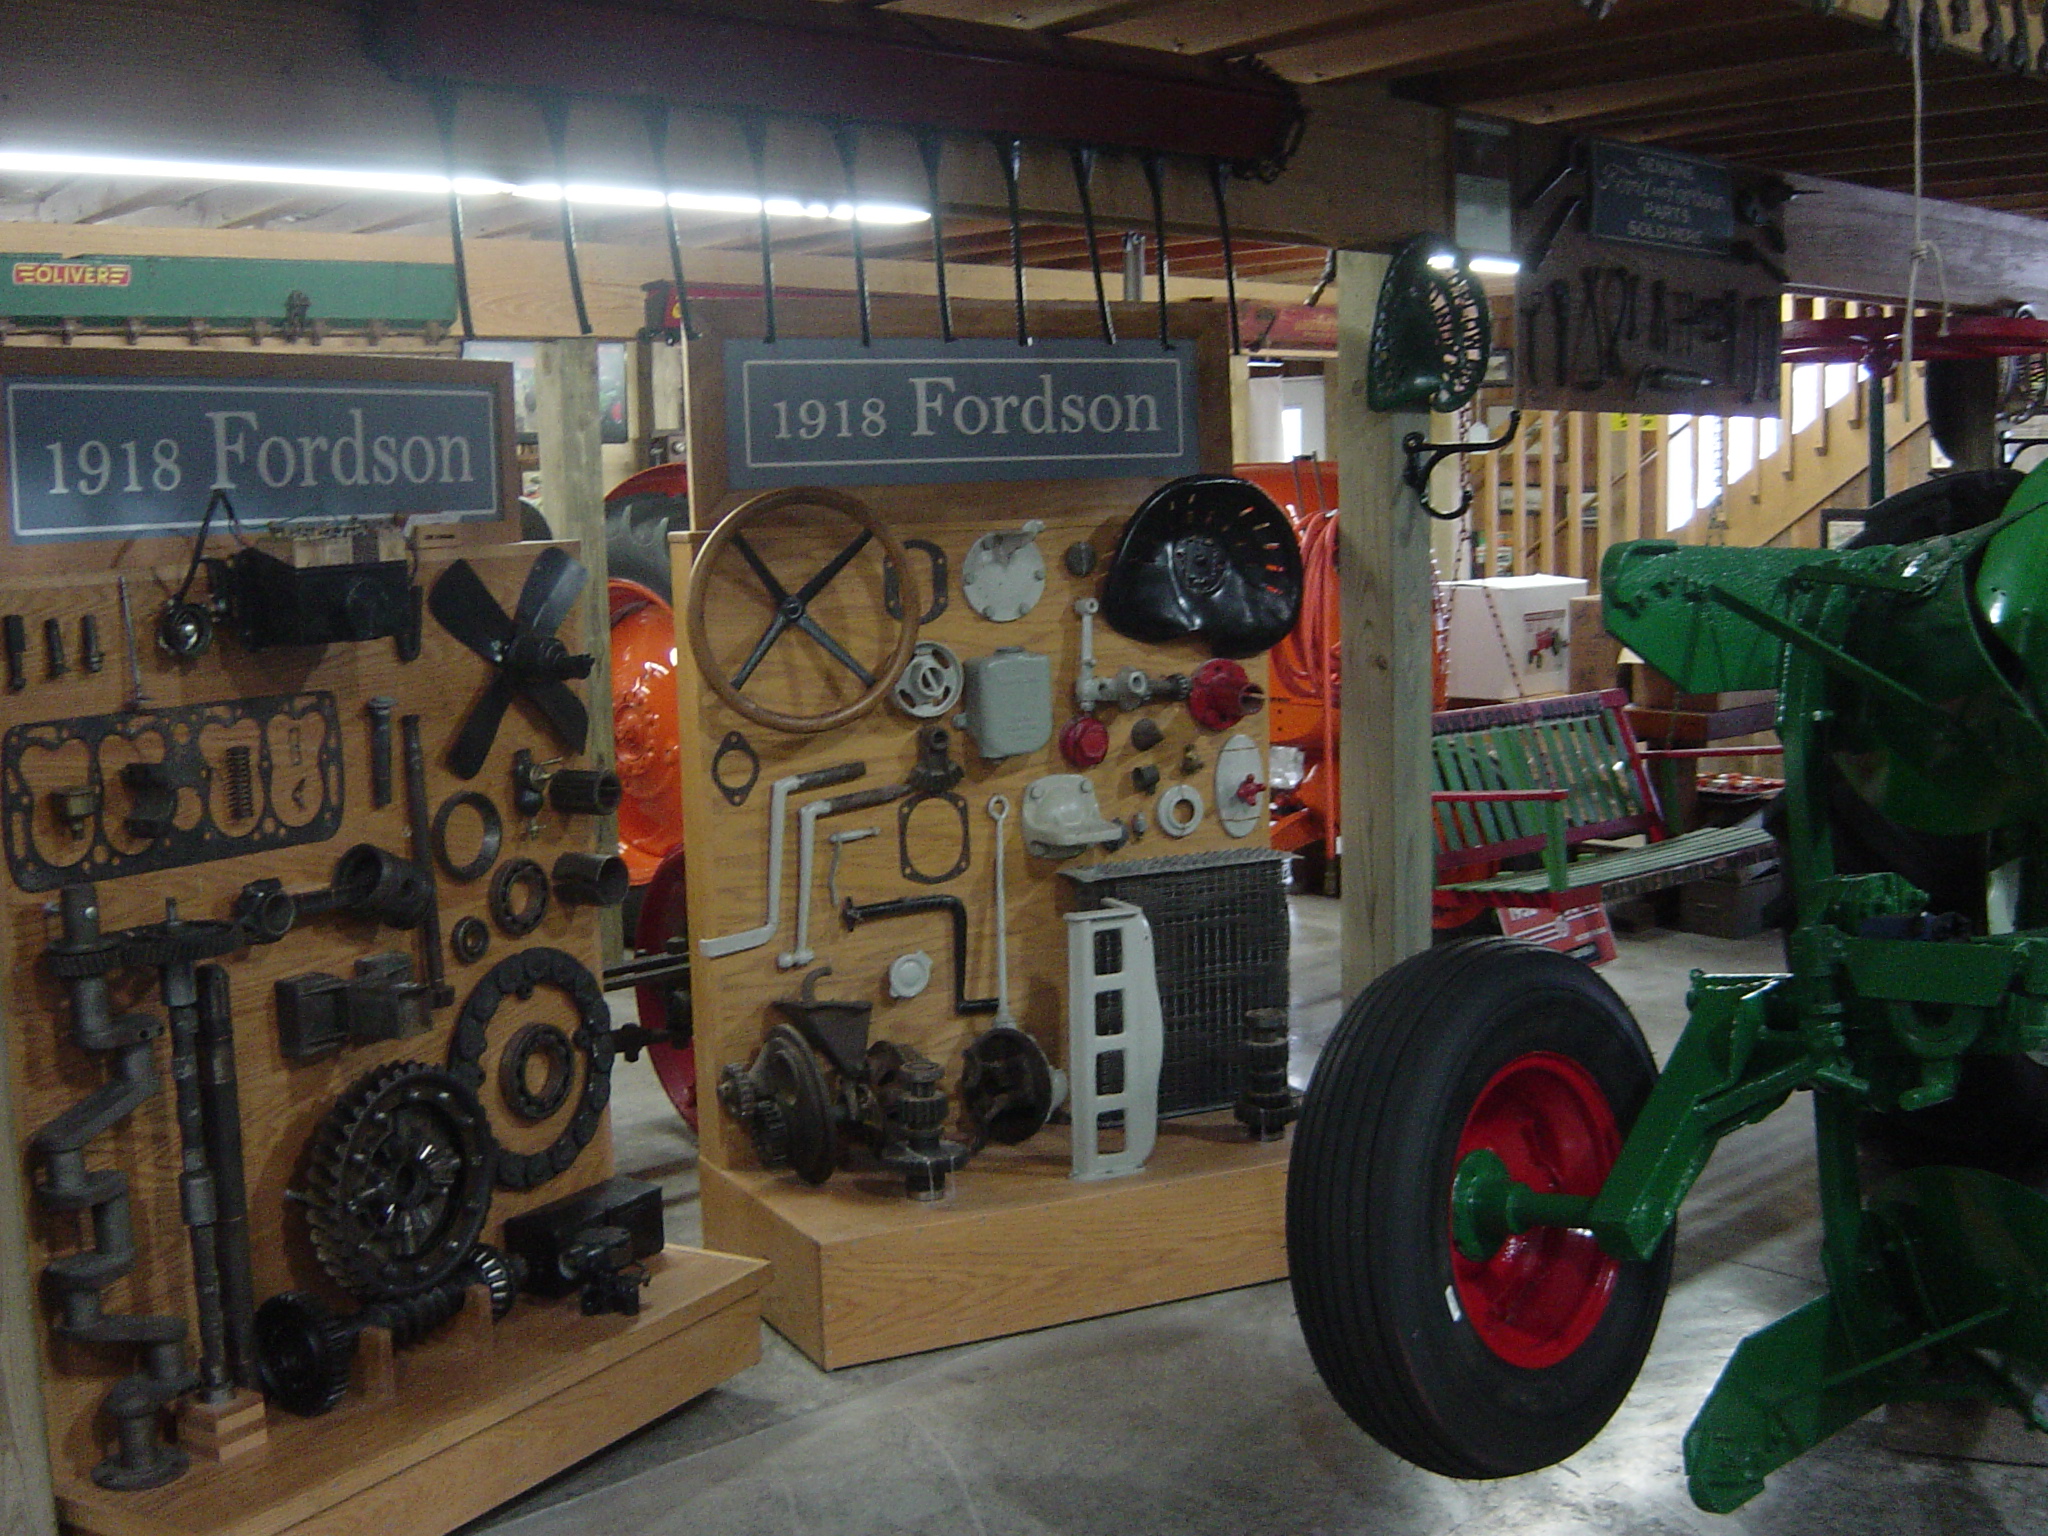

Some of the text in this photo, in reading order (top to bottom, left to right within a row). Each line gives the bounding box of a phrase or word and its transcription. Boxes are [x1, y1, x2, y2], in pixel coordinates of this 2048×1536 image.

[36, 265, 110, 284] OLIVER
[772, 373, 1161, 440] 1918 Fordson
[46, 408, 474, 496] 1918 Fordson
